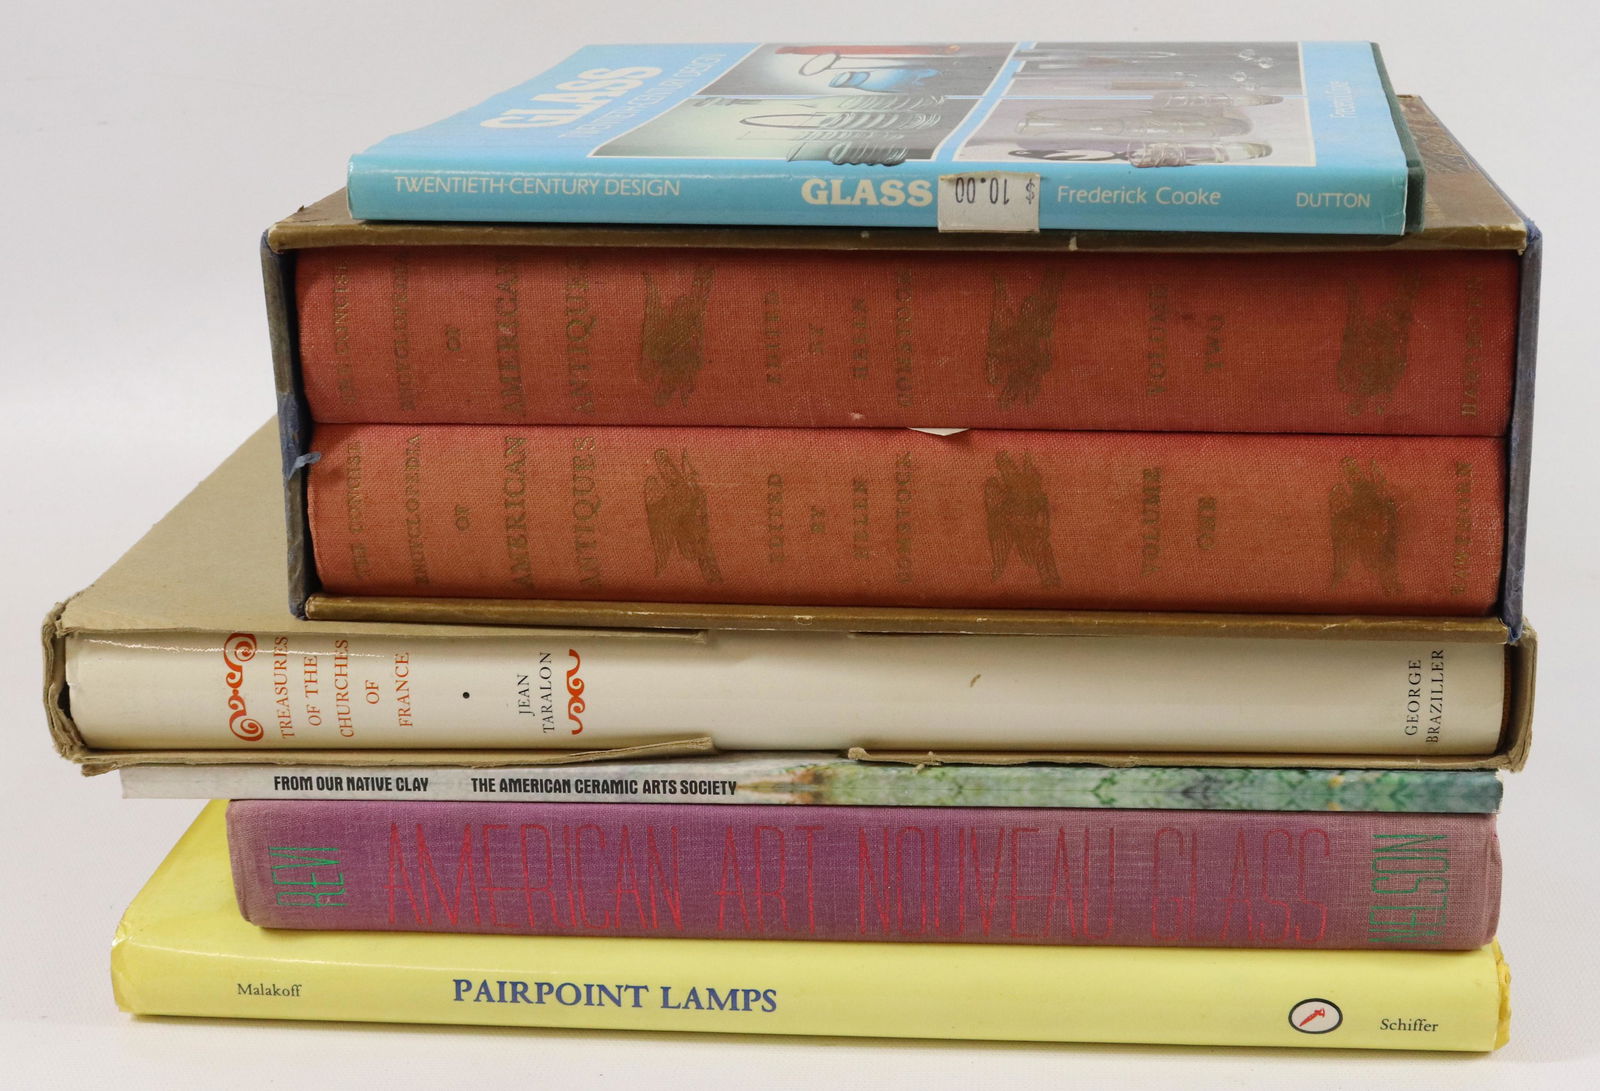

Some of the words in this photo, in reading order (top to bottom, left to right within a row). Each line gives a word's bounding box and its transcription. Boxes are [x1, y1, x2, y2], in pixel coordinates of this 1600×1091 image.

[480, 66, 663, 128] GLASS
[394, 176, 600, 195] TWENTIETH-CENTURY
[605, 179, 680, 196] DESIGN
[801, 178, 933, 207] GLASS
[955, 177, 1010, 205] 10.00
[1057, 186, 1147, 204] Frederick
[1156, 186, 1221, 206] Cooke
[1296, 192, 1370, 208] DUTTON
[444, 324, 461, 352] OF
[496, 253, 526, 417] AMERICAN
[565, 254, 595, 417] ANTIQUES
[404, 434, 430, 586] ENCYCLOPEDIA
[455, 504, 471, 531] OF
[504, 436, 534, 589] AMERICAN
[572, 435, 602, 592] ANTIQUES
[767, 473, 785, 563] EDITED
[810, 505, 826, 534] BY
[1141, 467, 1162, 577] VOLUME
[1196, 496, 1217, 551] ONE
[273, 636, 296, 739] TREASURES
[303, 655, 319, 698] THE
[334, 639, 354, 738] CHURCHES
[365, 680, 380, 705] OF
[395, 652, 413, 728] FRANCE
[516, 674, 535, 716] JEAN
[539, 652, 553, 733] TARALON
[1404, 660, 1421, 736] GEORGE
[1425, 649, 1444, 743] BRAZILLER
[305, 704, 322, 727] OF
[274, 776, 312, 792] FROM
[316, 776, 343, 792] OUR
[346, 777, 393, 793] NATIVE
[396, 778, 429, 793] CLAY
[471, 778, 496, 793] THE
[499, 778, 572, 794] AMERICAN
[575, 779, 638, 794] CERAMIC
[643, 780, 677, 795] ARTS
[680, 781, 737, 796] SOCIETY
[268, 847, 348, 908] REVI
[384, 823, 684, 933] AMERICAN
[714, 825, 824, 936] ART
[857, 826, 1116, 938] NOUVEAU
[1151, 827, 1331, 943] GLASS
[1368, 834, 1450, 944] NELSON
[236, 983, 302, 998] Malakoff
[453, 978, 649, 1008] PAIRPOINT
[661, 985, 778, 1013] LAMPS
[1379, 1018, 1439, 1032] Schiffer
